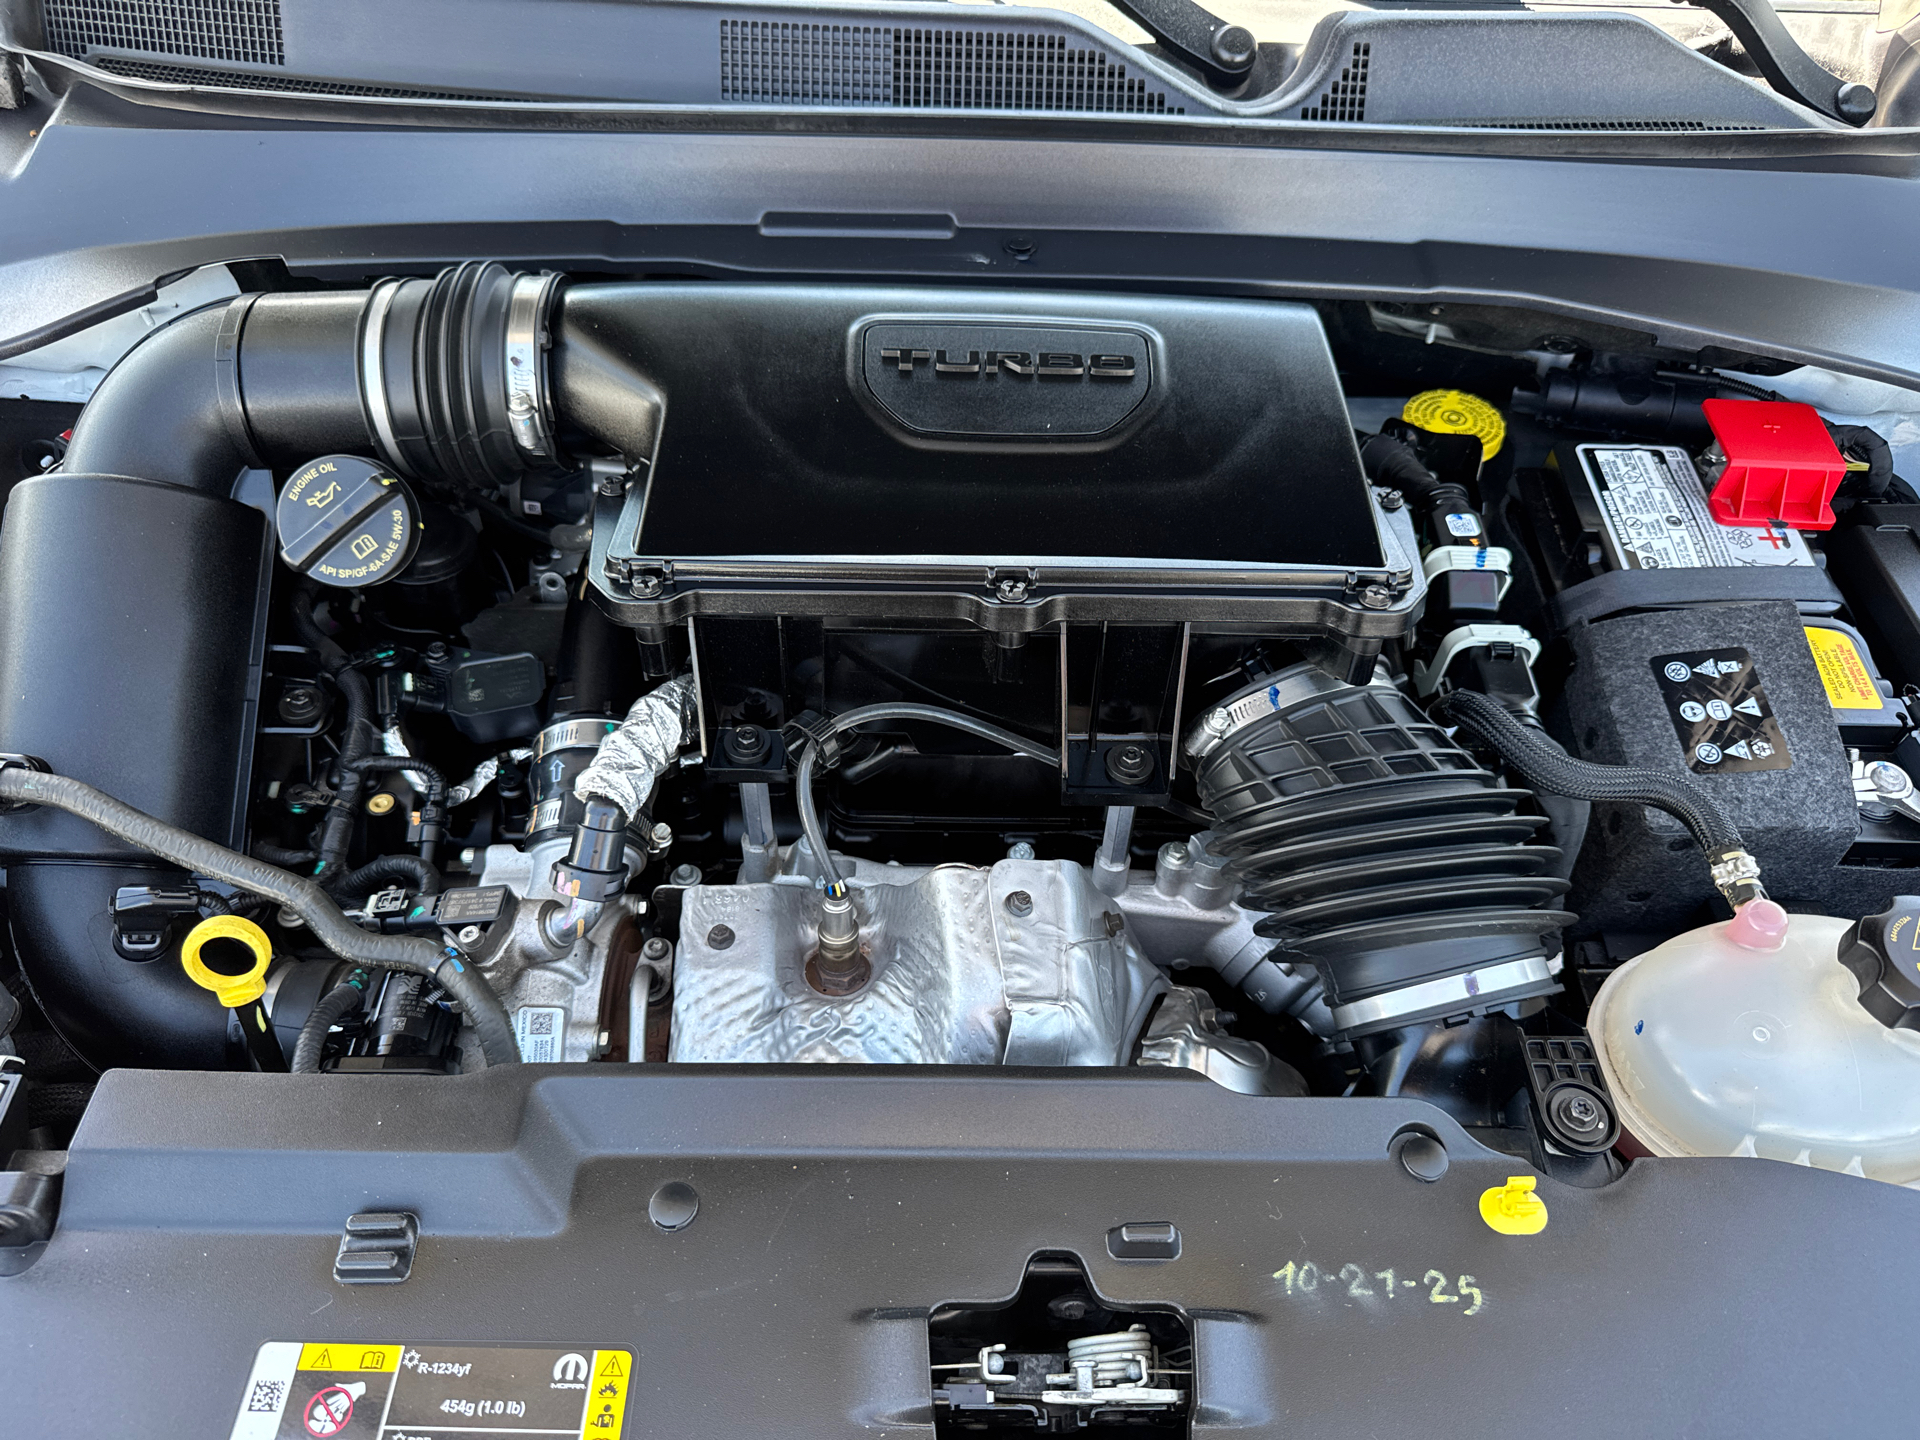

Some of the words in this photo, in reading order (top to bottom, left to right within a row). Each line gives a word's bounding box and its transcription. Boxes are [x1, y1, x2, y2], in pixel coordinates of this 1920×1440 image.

[880, 348, 1136, 376] TURBO
[288, 468, 319, 501] ENGINE
[319, 462, 337, 473] OIL
[1602, 491, 1630, 543] DANGER/POISON
[319, 564, 337, 576] API
[392, 510, 404, 540] 5W-30
[1811, 640, 1825, 662] BATTERY
[1821, 664, 1831, 676] AGM
[1830, 648, 1856, 692] NON-SPILLABLE
[1831, 668, 1840, 678] NOT
[1828, 677, 1842, 700] SEALED
[1837, 680, 1845, 688] DO
[1272, 1260, 1483, 1316] 10-21-25
[417, 1362, 473, 1377] R-1234yf
[550, 1382, 587, 1390] MOPAR
[440, 1399, 476, 1416] 454g
[477, 1401, 505, 1417] (1.0
[506, 1401, 526, 1418] lb)
